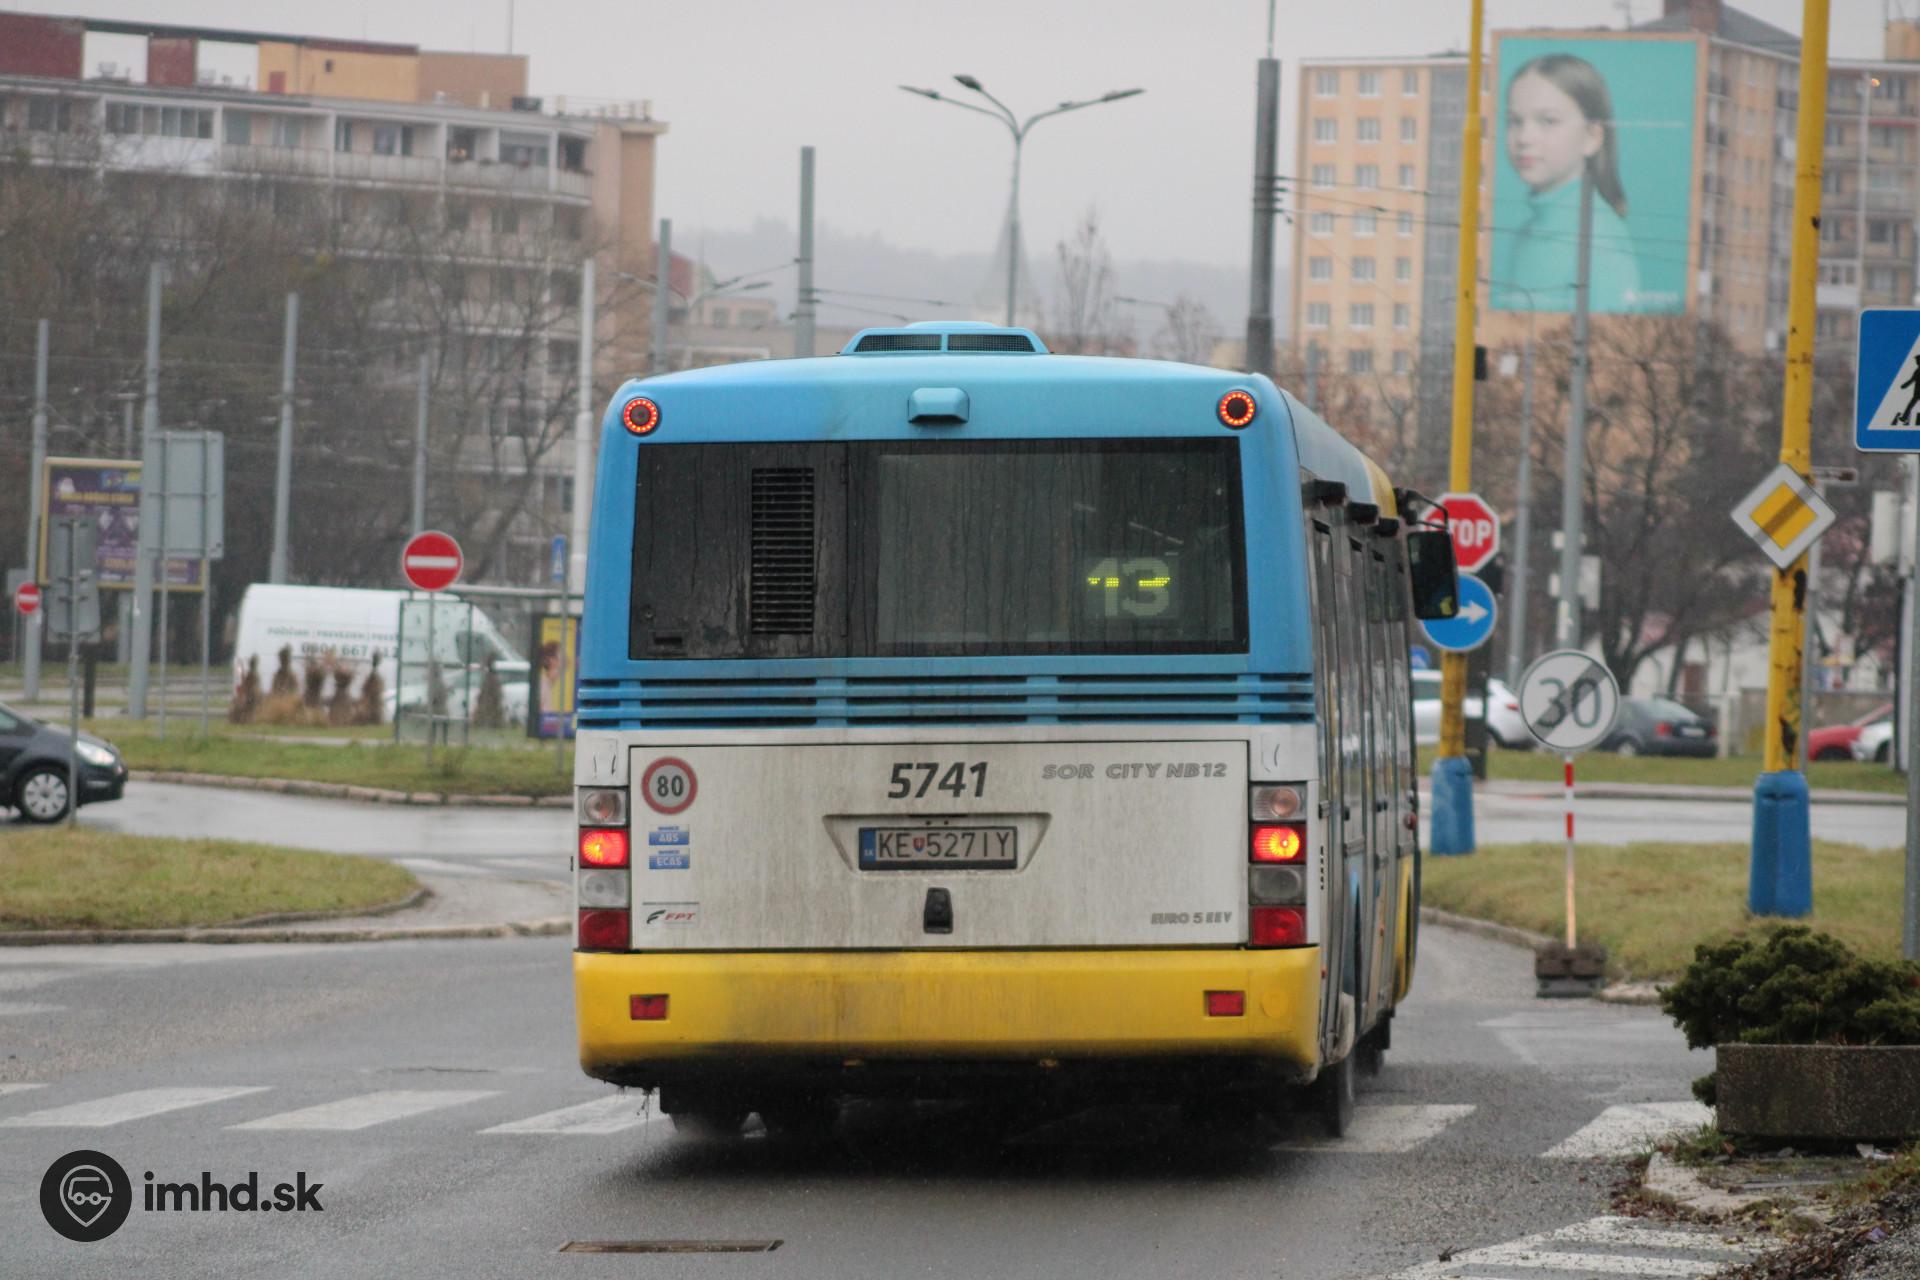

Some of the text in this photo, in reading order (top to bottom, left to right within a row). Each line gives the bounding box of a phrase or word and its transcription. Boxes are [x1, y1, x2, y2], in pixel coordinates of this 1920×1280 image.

[1425, 518, 1491, 548] OP
[1086, 557, 1170, 617] 13
[342, 643, 369, 656] 667
[1536, 677, 1602, 729] 30
[888, 762, 988, 798] 5741
[1041, 762, 1227, 779] SOR CITY NB12
[657, 775, 684, 797] 80
[878, 831, 1010, 858] KE 527IY
[1151, 911, 1232, 924] EURO 5 EEV
